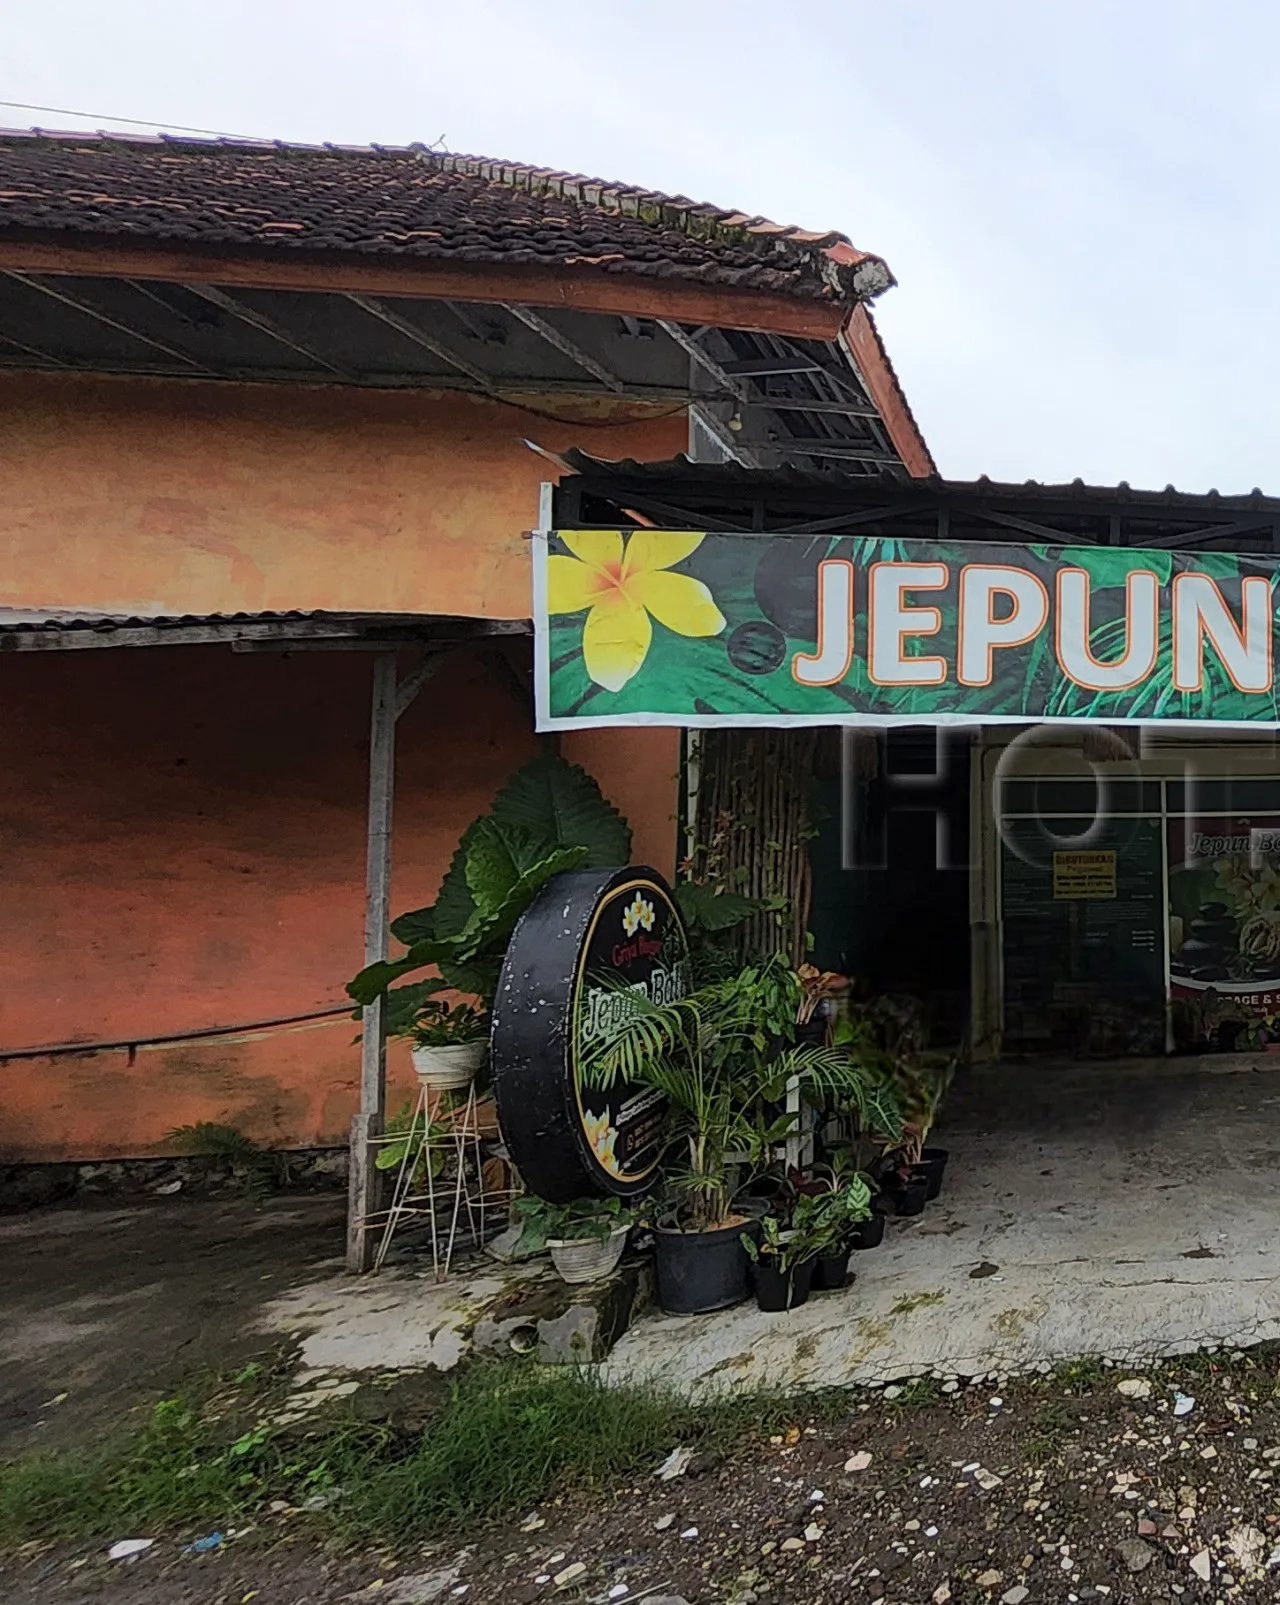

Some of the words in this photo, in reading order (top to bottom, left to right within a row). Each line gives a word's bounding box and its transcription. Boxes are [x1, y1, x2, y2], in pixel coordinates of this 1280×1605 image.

[792, 559, 1273, 693] JEPUN
[1188, 832, 1251, 856] Jepun
[1263, 994, 1273, 1004] &
